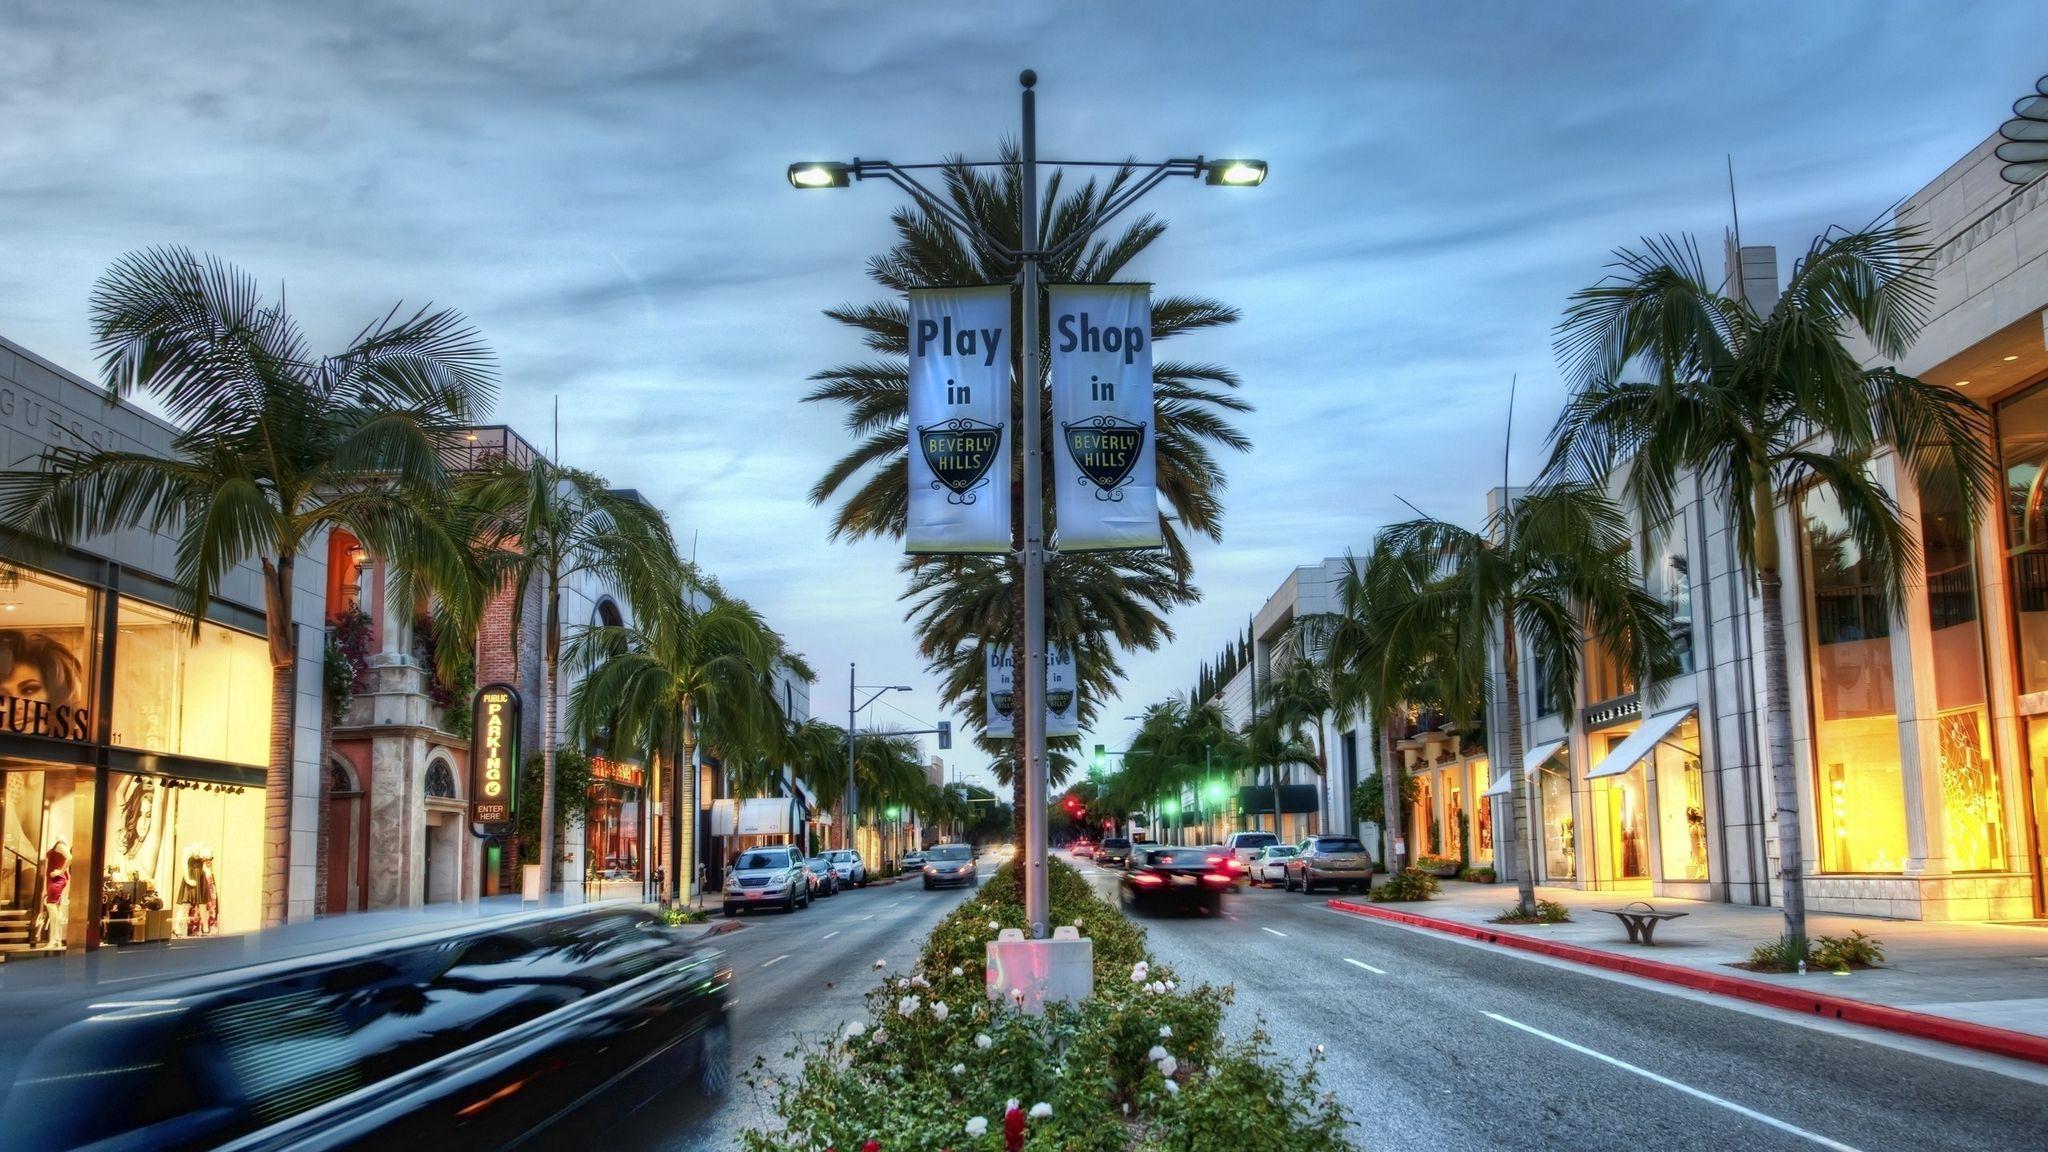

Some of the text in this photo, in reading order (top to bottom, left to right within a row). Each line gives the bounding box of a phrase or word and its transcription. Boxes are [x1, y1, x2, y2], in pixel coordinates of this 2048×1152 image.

[917, 315, 1003, 367] Play
[1057, 312, 1144, 365] Shop
[946, 378, 971, 405] in
[1090, 375, 1115, 402] in
[929, 436, 991, 453] BEVERLY
[1074, 434, 1135, 449] BEVERLY
[939, 454, 982, 471] HILLS
[1084, 451, 1126, 468] HILLS
[1001, 674, 1010, 684] in
[1053, 672, 1062, 682] in
[483, 694, 508, 703] PUBLIC
[486, 703, 502, 781] PARKING
[478, 805, 504, 813] ENTER
[480, 812, 501, 820] HERE
